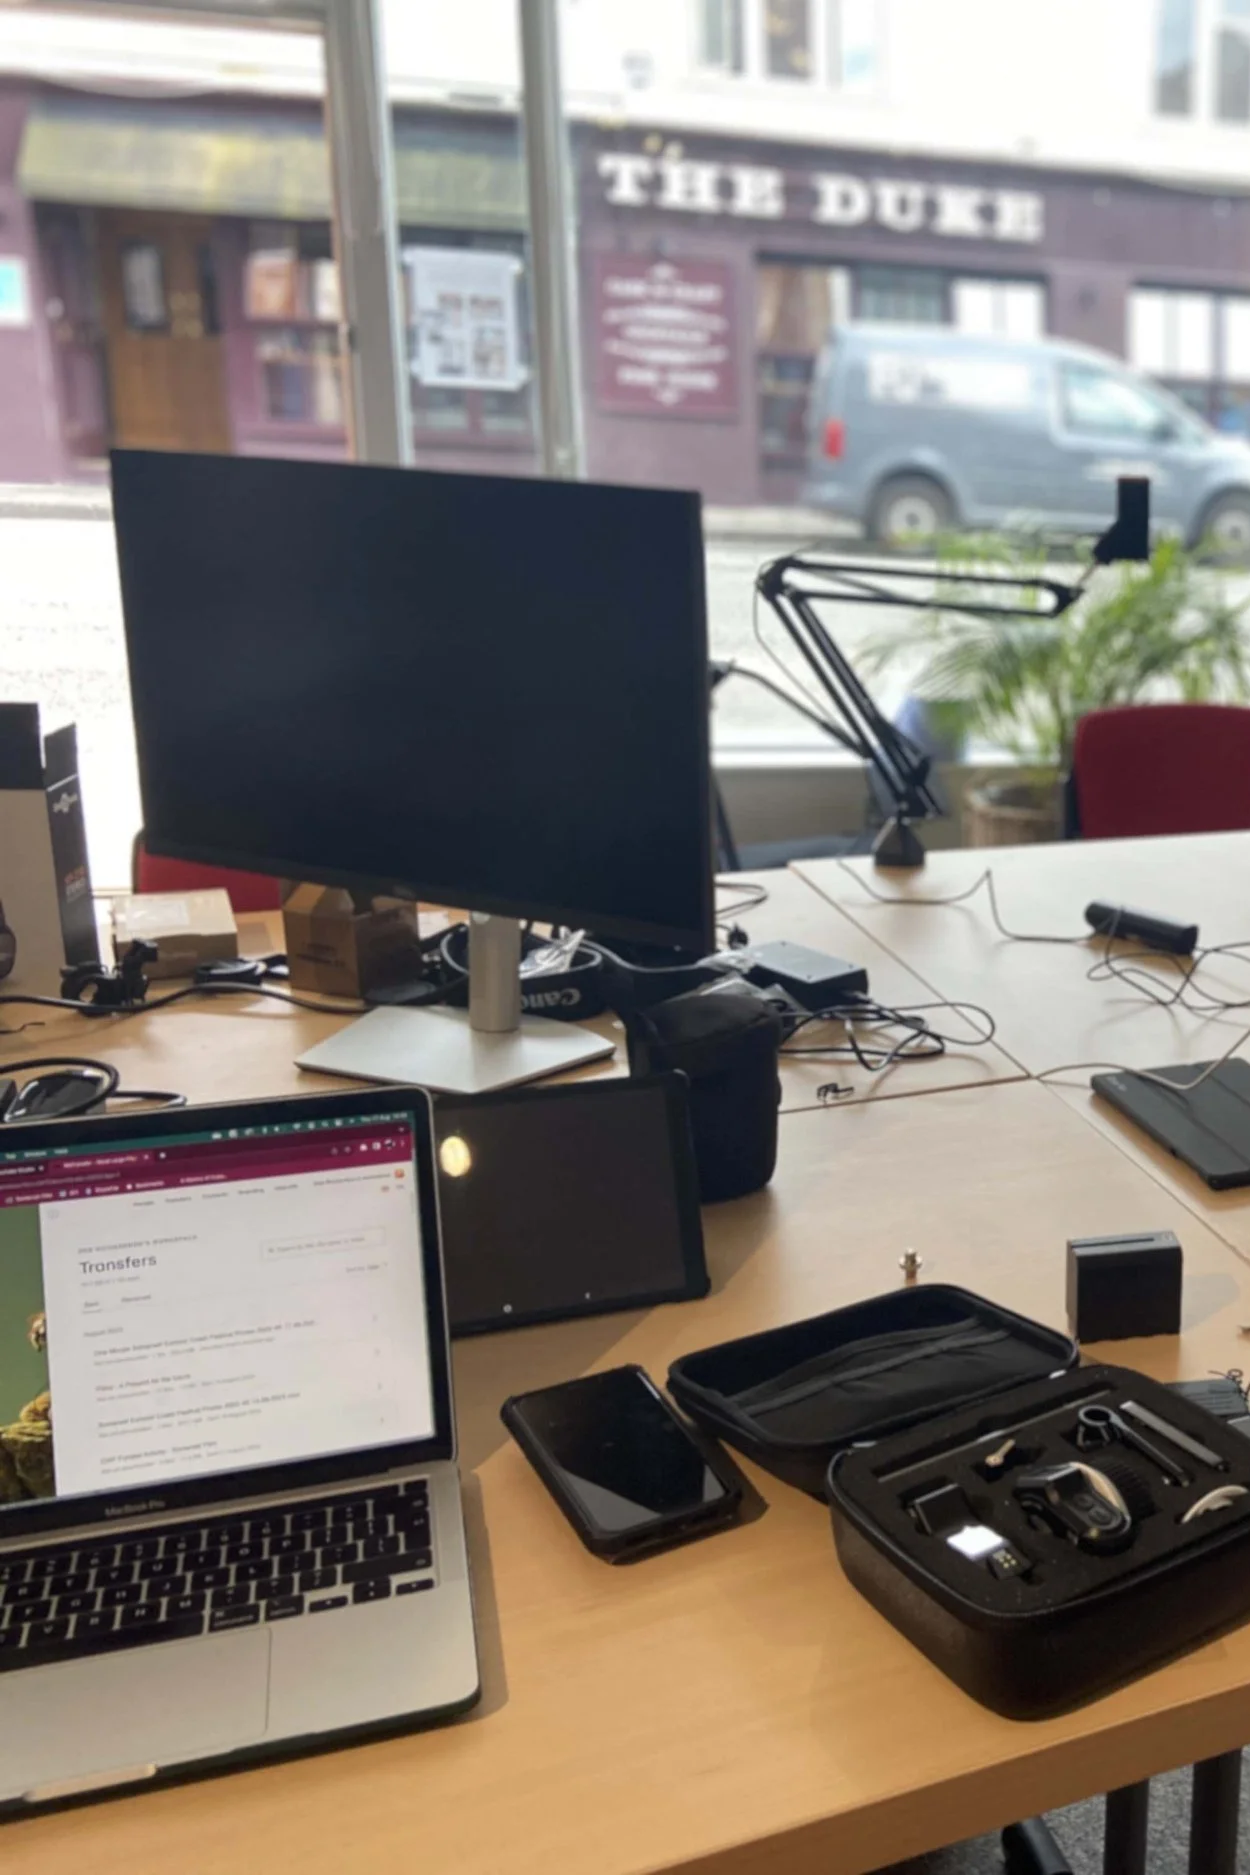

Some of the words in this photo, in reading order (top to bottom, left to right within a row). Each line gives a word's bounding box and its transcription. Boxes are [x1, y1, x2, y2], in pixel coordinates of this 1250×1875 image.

[597, 153, 786, 220] THE
[812, 174, 1045, 243] DUKE
[520, 987, 582, 1010] Cano
[79, 1254, 158, 1275] Transfers
